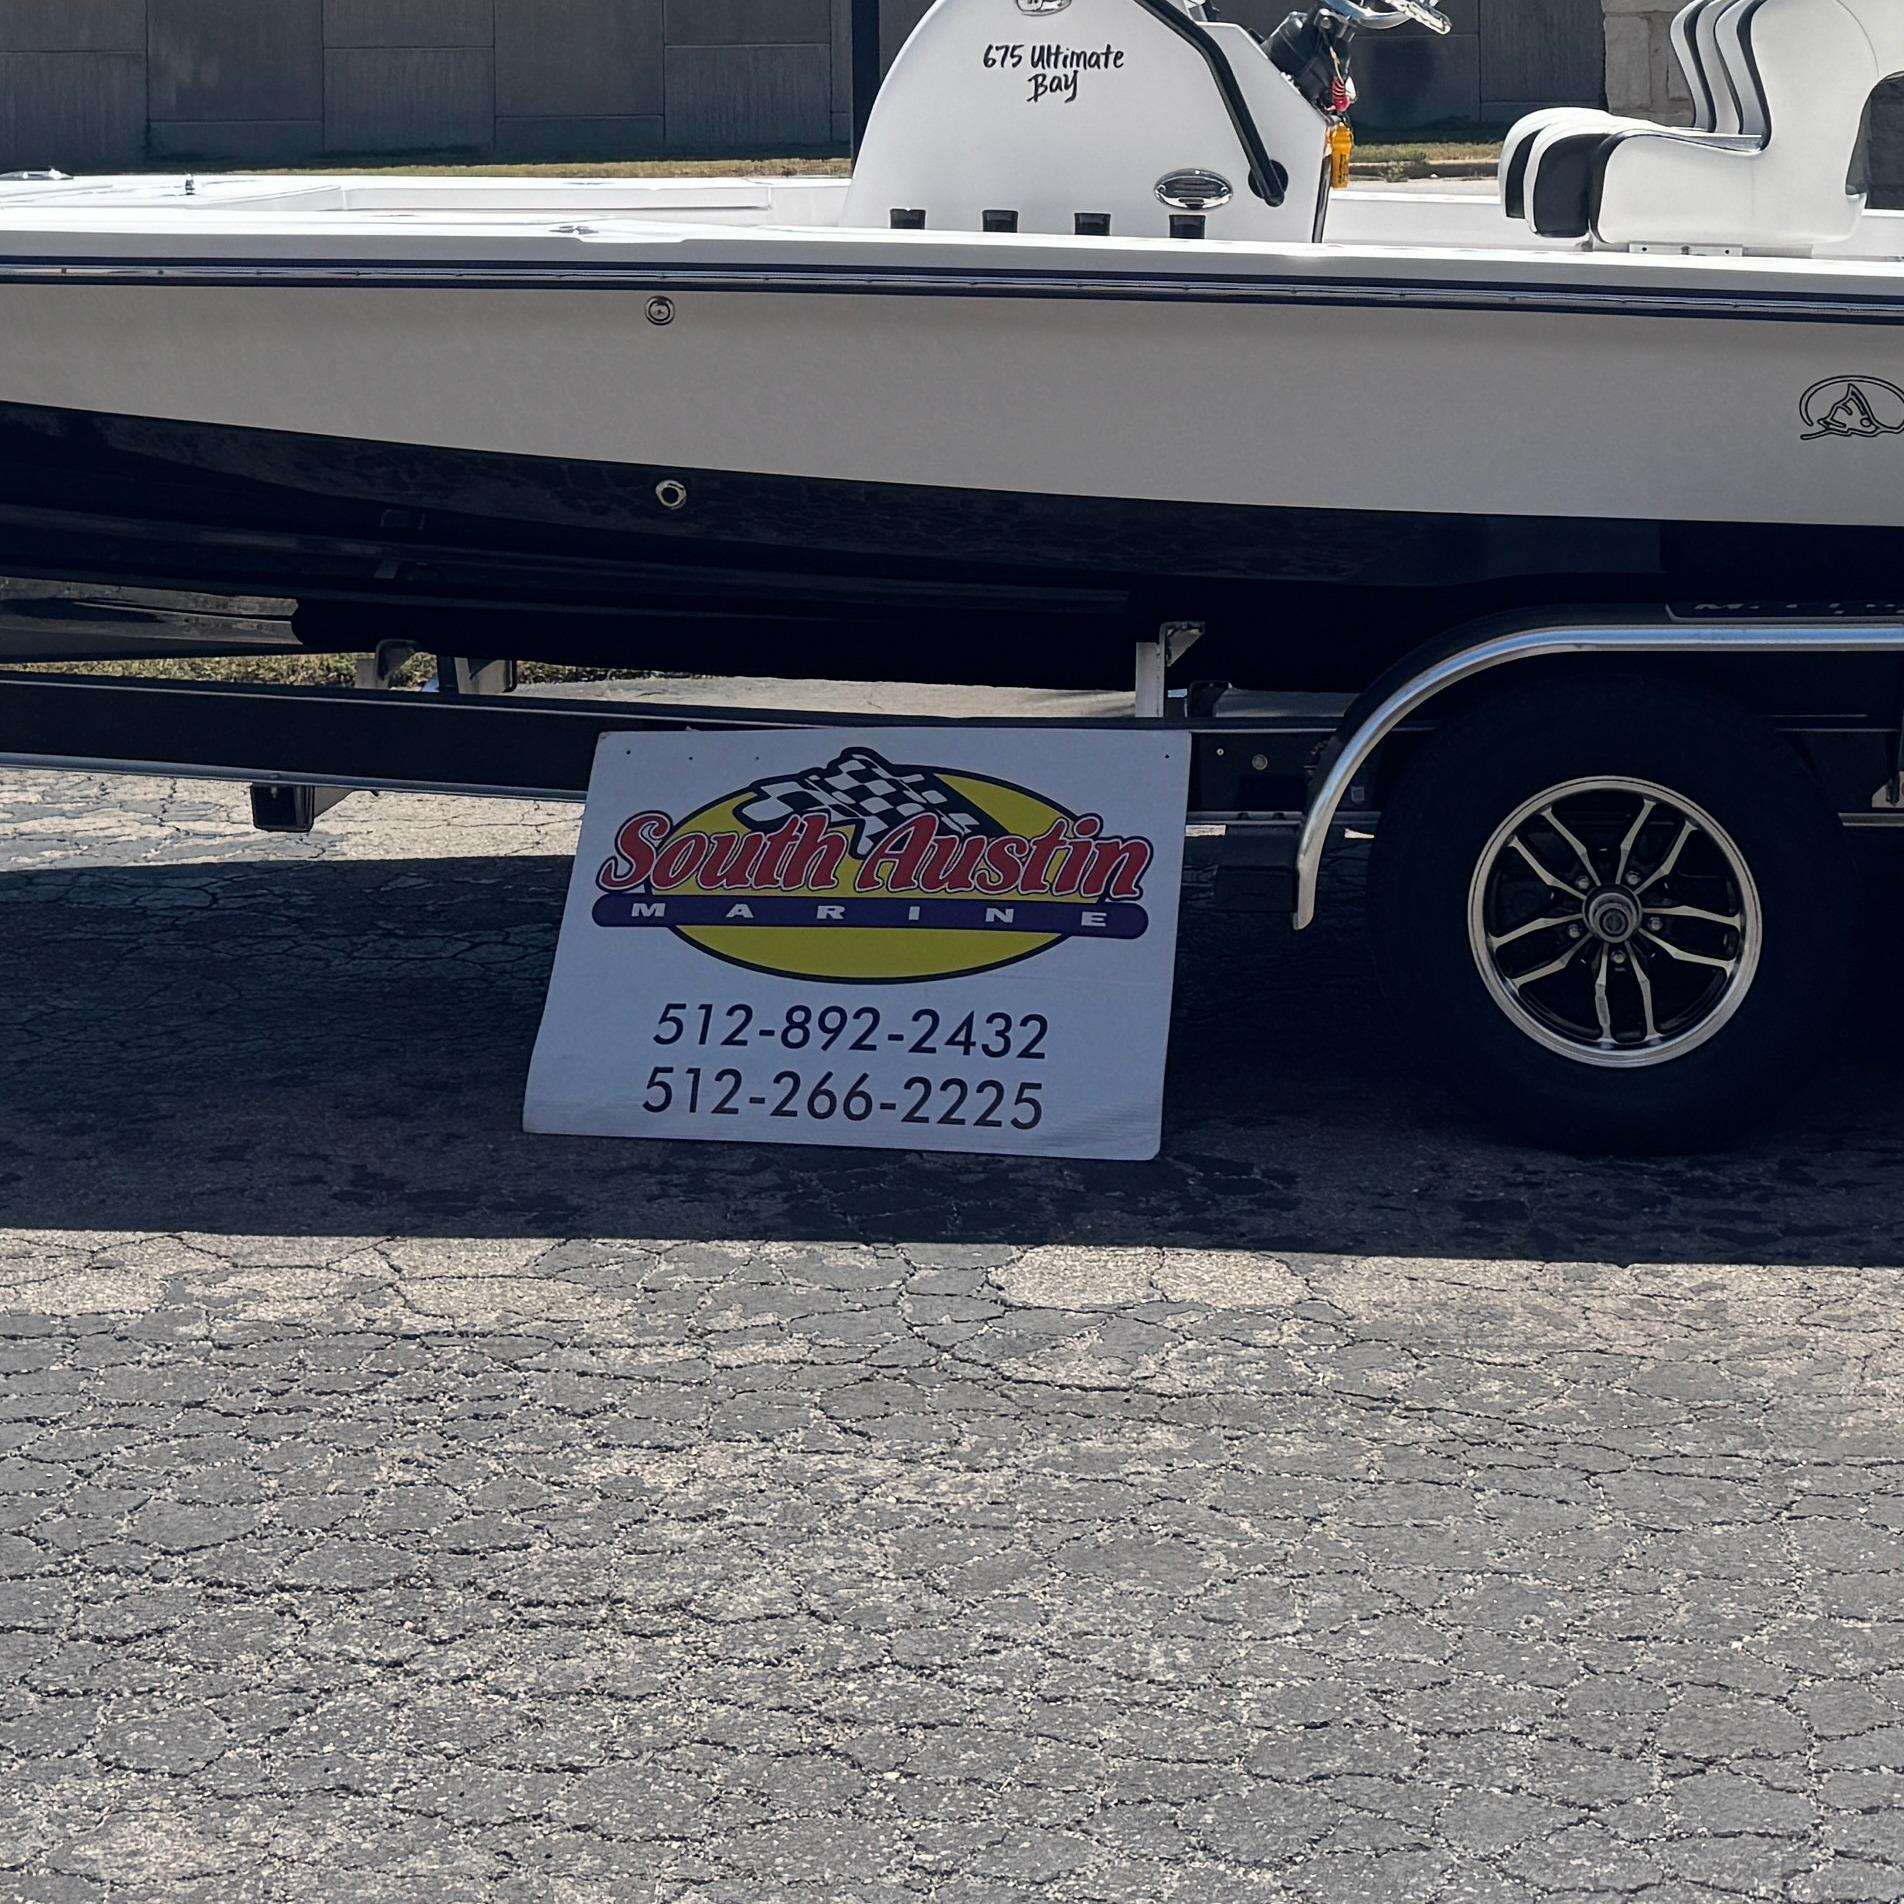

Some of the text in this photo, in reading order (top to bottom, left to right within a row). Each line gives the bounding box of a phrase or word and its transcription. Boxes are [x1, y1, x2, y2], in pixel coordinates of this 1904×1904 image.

[983, 43, 1125, 70] 675 Ultimate
[1027, 70, 1080, 103] Bay
[596, 810, 1152, 902] South Austin
[630, 902, 1108, 928] MARINE
[652, 1003, 1050, 1060] 512-892-2432
[641, 1066, 1044, 1130] 512-266-2225
